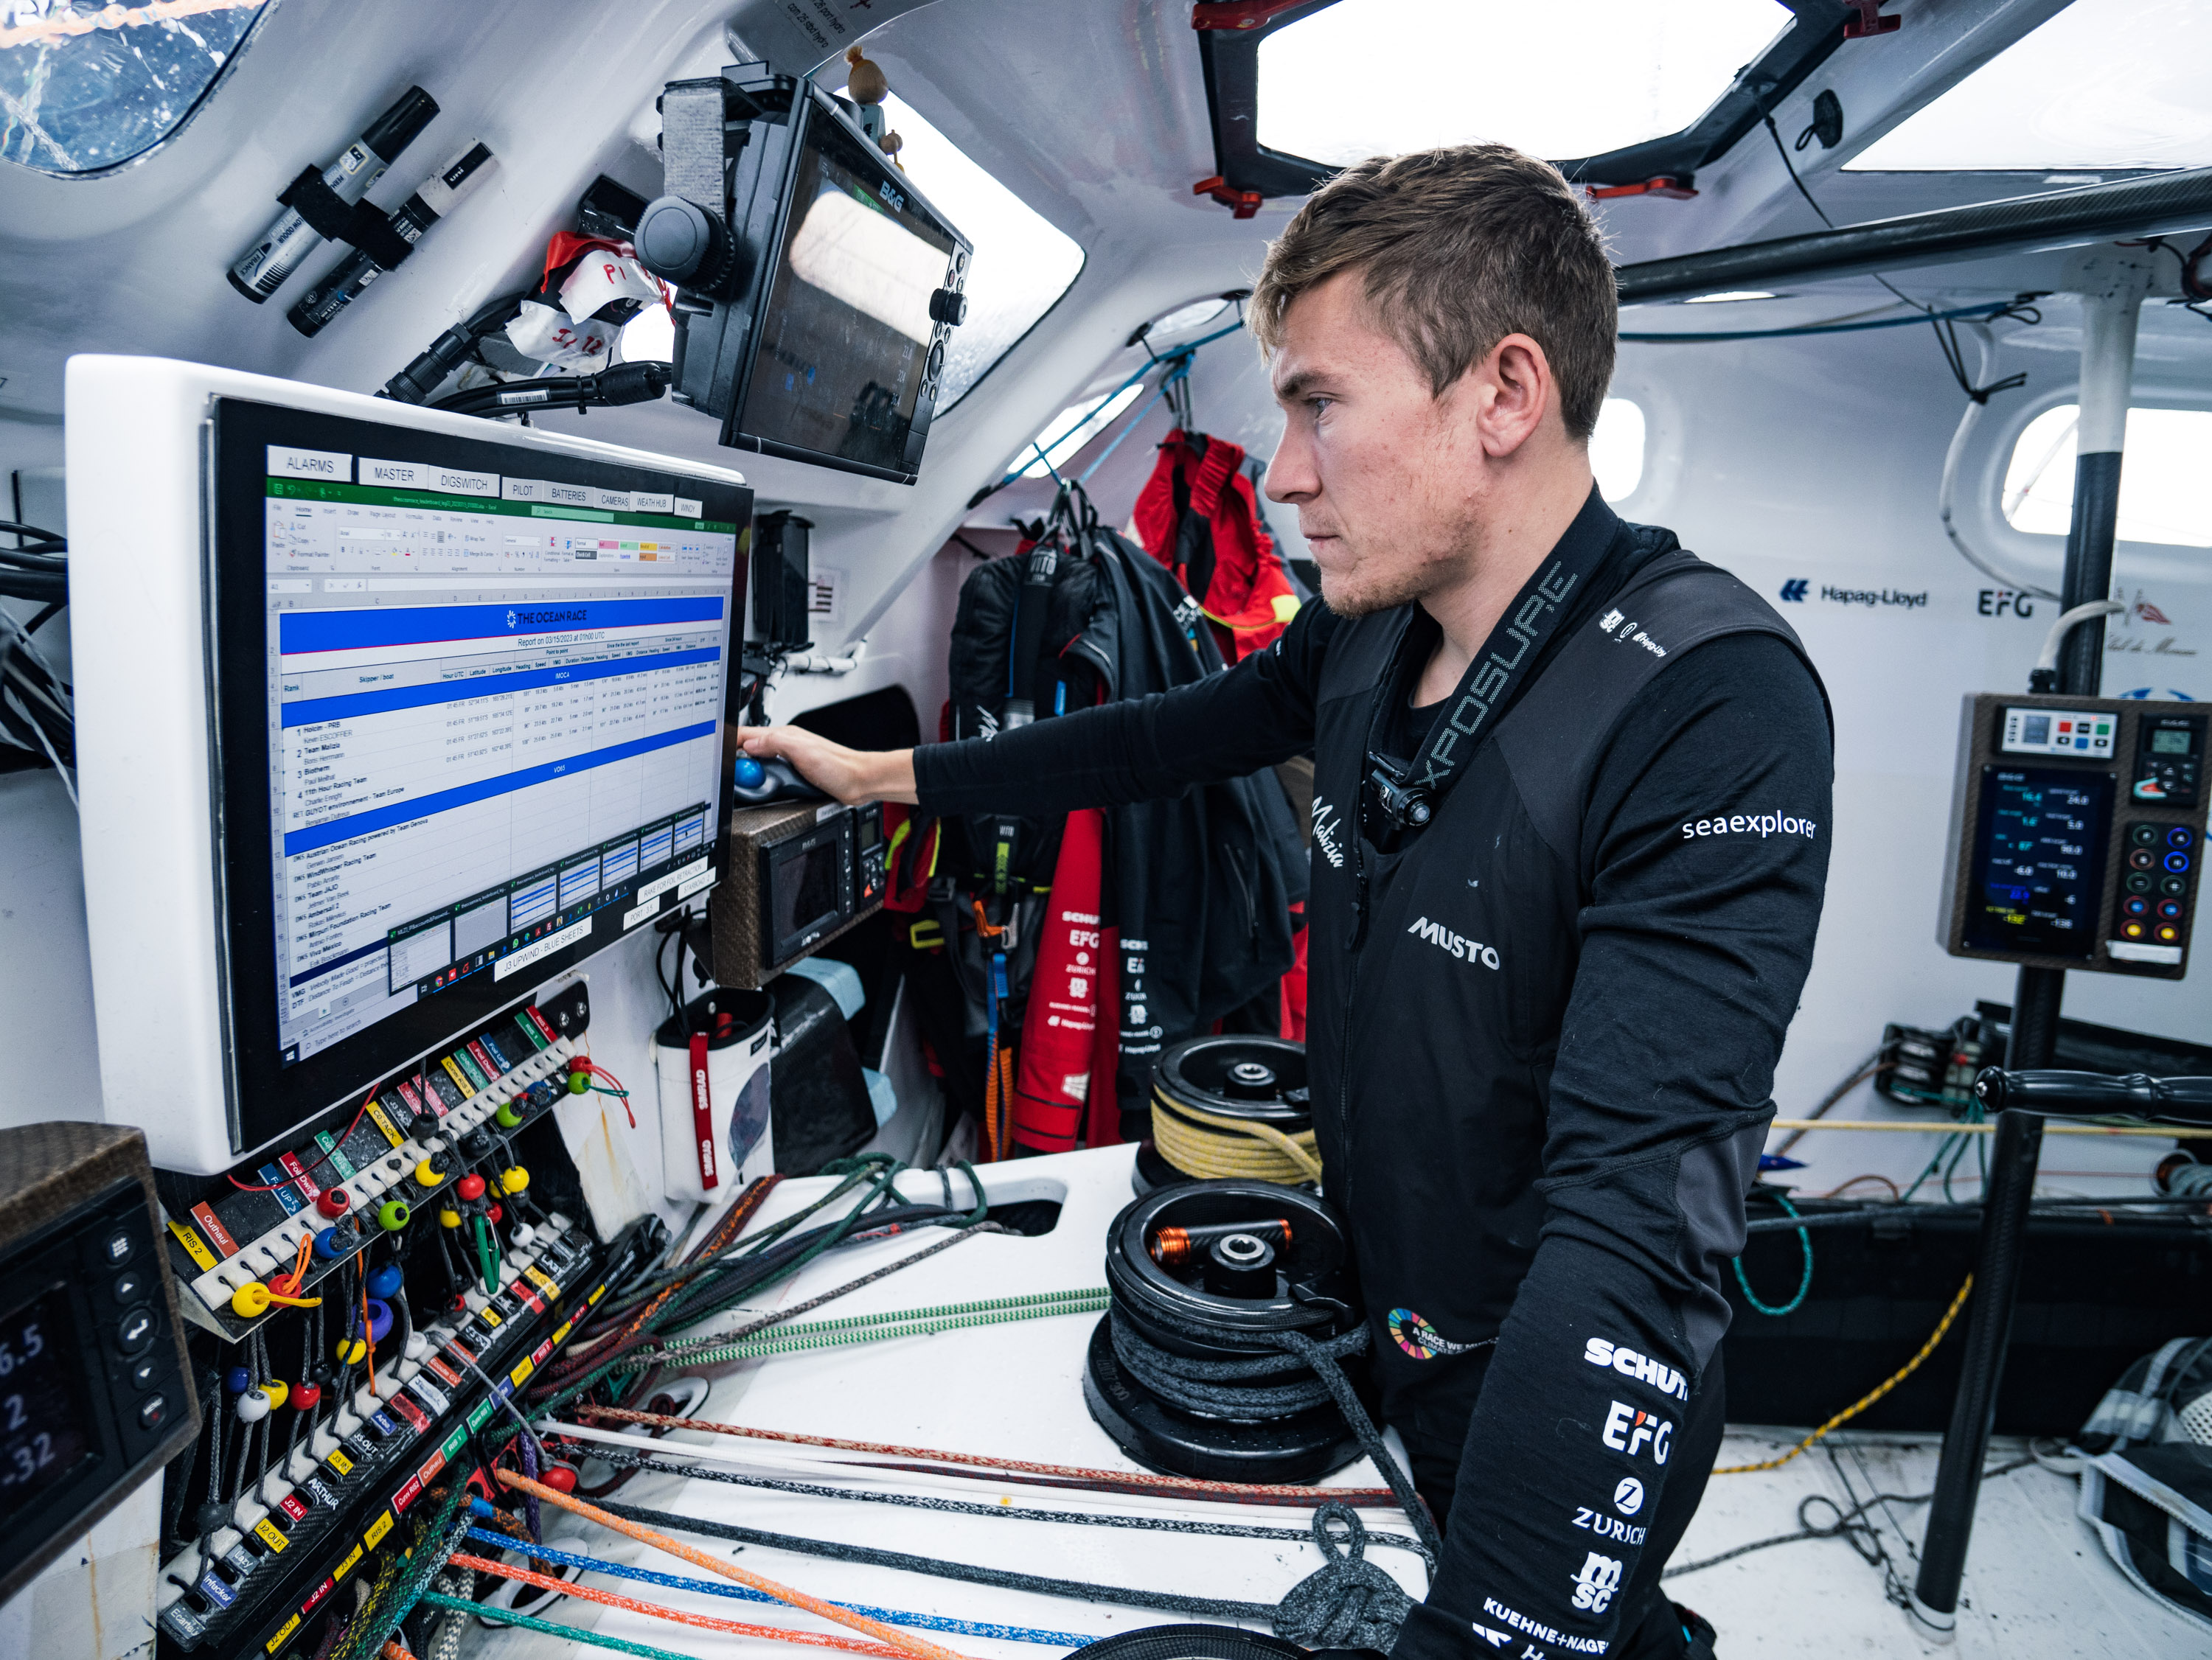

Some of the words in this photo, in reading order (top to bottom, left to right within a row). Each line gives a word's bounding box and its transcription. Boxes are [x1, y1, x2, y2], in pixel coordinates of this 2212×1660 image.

[829, 16, 846, 35] hydro
[811, 29, 830, 49] hydro
[449, 167, 465, 182] uni
[879, 180, 905, 213] B&G
[292, 217, 305, 230] LOW
[276, 226, 295, 244] ODOUR
[240, 254, 261, 276] FRANCE
[286, 456, 335, 474] ALARMS
[375, 467, 415, 482] MASTER
[440, 474, 489, 490] DIGSWITCH
[512, 484, 534, 496] PILOT
[552, 487, 587, 502] BATTERIES
[601, 495, 630, 508] CAMERAS
[636, 497, 655, 508] WEATH
[655, 499, 667, 508] HUB
[296, 506, 313, 514] Home
[680, 503, 696, 514] WINDY
[1820, 585, 1928, 610] Hapag-Lloyd
[1978, 590, 2034, 618] EFG
[517, 612, 535, 624] THE
[536, 610, 566, 624] OCEAN
[567, 609, 588, 621] RACE
[518, 637, 536, 648] Report
[545, 634, 573, 645] 03/15/2023
[573, 634, 580, 642] at
[579, 632, 594, 641] 01h00
[594, 631, 606, 639] UTC
[284, 684, 300, 693] Rank
[358, 675, 380, 683] Skipper
[493, 666, 512, 674] Longitude
[1414, 561, 1578, 790] XPOSURE
[296, 729, 302, 737] 1
[303, 725, 324, 734] Holcim
[296, 749, 302, 758] 2
[303, 747, 321, 756] Team
[321, 742, 341, 752] Malizia
[297, 770, 303, 779] 3
[304, 764, 331, 775] Biotherm
[297, 791, 303, 799] 4
[318, 784, 333, 793] Hour
[333, 779, 353, 792] Racing
[352, 776, 368, 785] Team
[305, 806, 328, 817] GUYOT
[327, 795, 369, 812] environnement
[372, 792, 386, 801] Team
[386, 786, 406, 798] Europe
[1312, 795, 1343, 868] Malizia
[1682, 809, 1817, 840] seaexplorer
[306, 847, 330, 860] Austrian
[330, 841, 348, 852] Ocean
[348, 836, 367, 848] Racing
[367, 829, 390, 842] powered
[389, 827, 397, 836] by
[397, 823, 410, 833] Team
[409, 817, 429, 830] Genova
[306, 863, 344, 880] WindWhisper
[343, 857, 363, 868] Racing
[362, 851, 378, 861] Team
[307, 889, 324, 899] Team
[323, 883, 340, 893] JAJO
[644, 885, 657, 899] RAKE
[656, 880, 667, 892] FOR
[676, 863, 703, 882] RETRACTION
[307, 905, 335, 919] Ambersail
[308, 925, 329, 939] Mirpuri
[329, 914, 360, 930] Foundation
[359, 907, 378, 920] Racing
[378, 902, 392, 911] Team
[504, 962, 512, 972] J3
[512, 946, 540, 968] UPWIND
[543, 936, 560, 952] BLUE
[560, 924, 584, 944] SHEETS
[1069, 929, 1100, 949] EFG
[1408, 916, 1500, 971] MUSTO
[309, 949, 322, 959] Viva
[291, 988, 306, 1000] VMG
[330, 969, 345, 982] Made
[344, 963, 361, 975] Good
[314, 1036, 327, 1047] Type
[327, 1030, 339, 1039] here
[346, 1019, 362, 1031] search
[389, 1101, 399, 1110] J3
[381, 1119, 397, 1140] TACK
[288, 1161, 301, 1177] Foil
[299, 1175, 314, 1193] Dwn
[279, 1189, 293, 1204] UP
[203, 1213, 229, 1246] Outhaul
[182, 1231, 199, 1249] RIS
[193, 1247, 204, 1256] 2
[1412, 1327, 1420, 1336] A
[1421, 1330, 1446, 1347] RACE
[1446, 1341, 1464, 1350] WE
[1417, 1336, 1455, 1355] CLIMATE
[1584, 1337, 1688, 1401] SCHÜT
[3, 1393, 29, 1431] 2
[1602, 1400, 1673, 1465] EFG
[331, 1455, 341, 1465] J3
[339, 1462, 350, 1471] IN
[422, 1456, 443, 1479] Outhaul
[307, 1477, 340, 1510] ARTHUR
[397, 1490, 411, 1506] Cunni
[284, 1498, 294, 1509] J2
[291, 1505, 304, 1517] IN
[259, 1524, 270, 1535] J2
[268, 1532, 285, 1548] OUT
[371, 1527, 383, 1541] RIS
[380, 1521, 388, 1529] 2
[1571, 1506, 1647, 1546] ZURICH
[233, 1549, 254, 1569] Lazy
[340, 1560, 349, 1572] J3
[347, 1552, 357, 1563] IN
[203, 1574, 233, 1603] Infucker
[310, 1591, 320, 1603] J2
[316, 1582, 329, 1594] IN
[270, 1633, 280, 1647] J2
[277, 1615, 296, 1637] OUT
[1483, 1597, 1610, 1656] KUEHNE+NAGE
